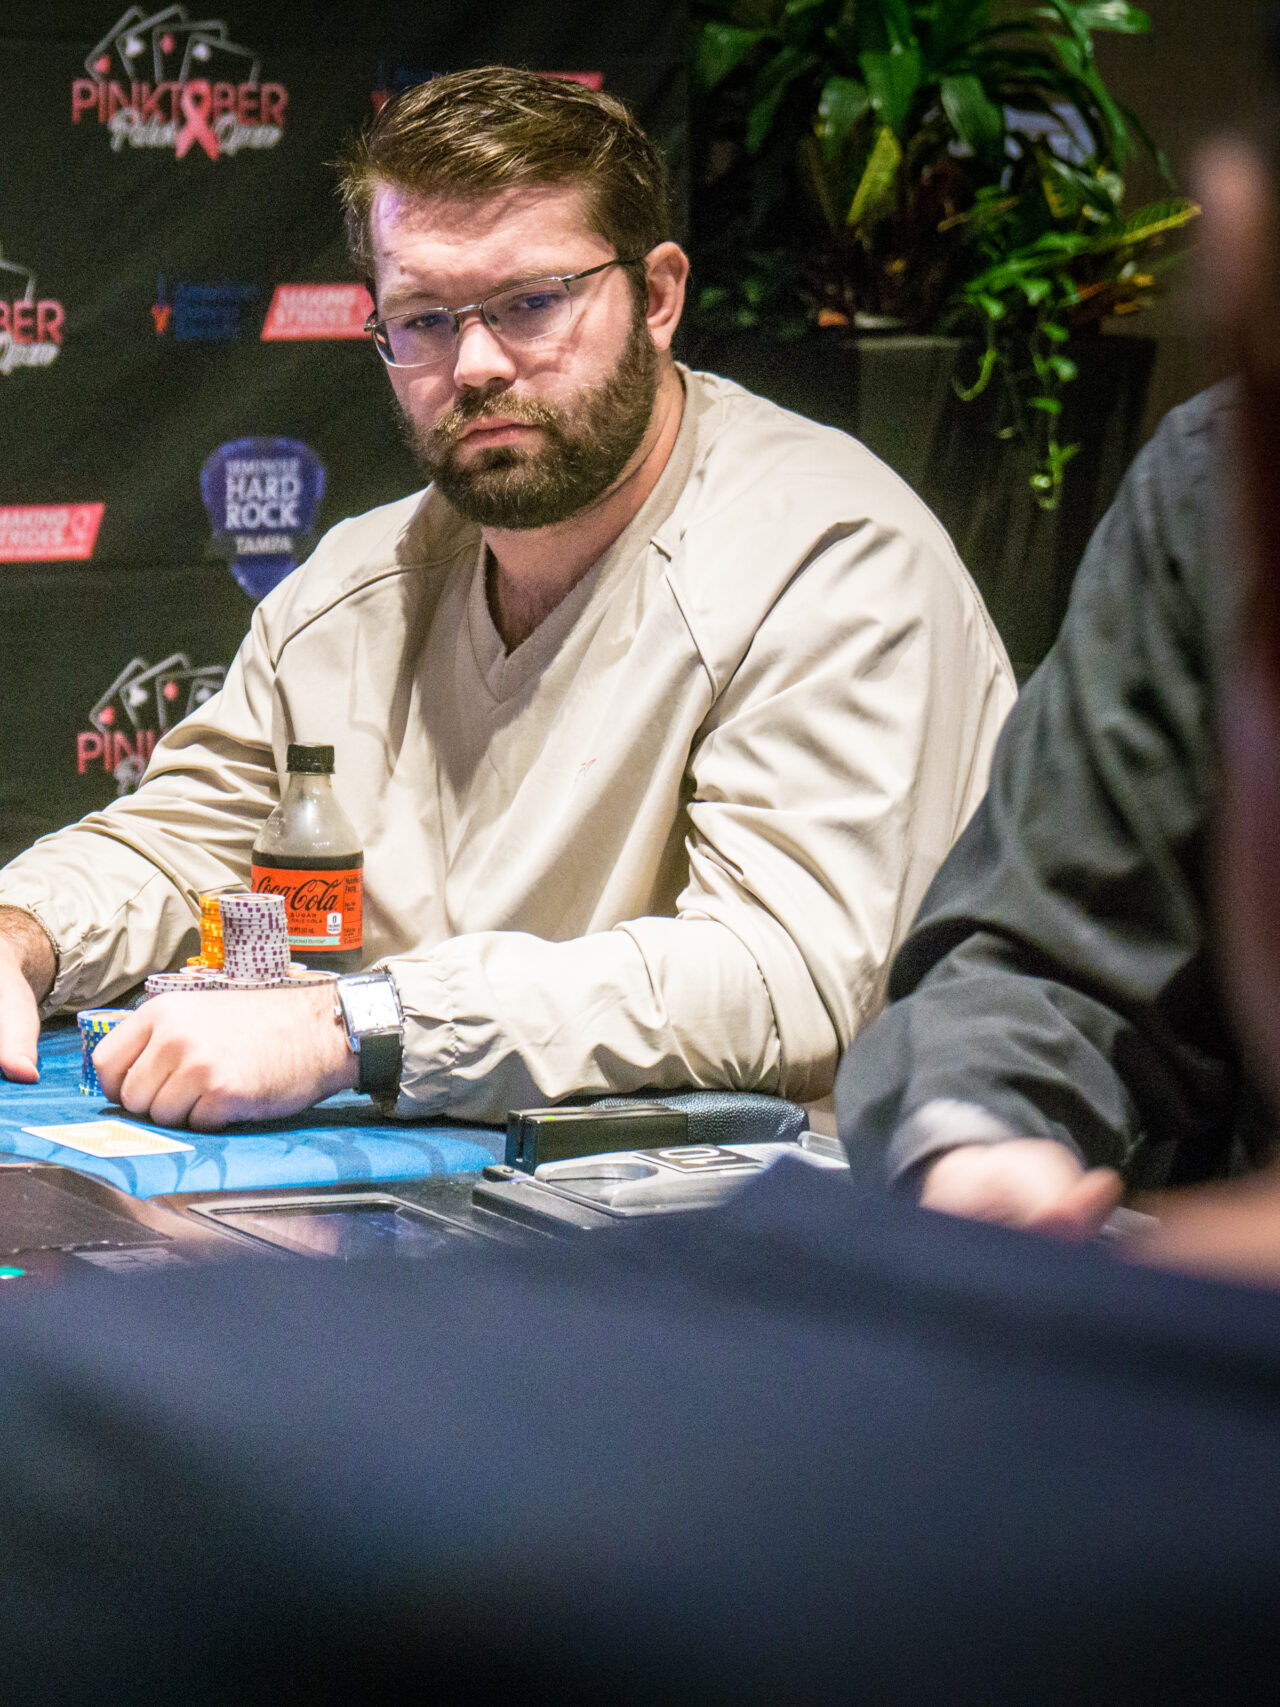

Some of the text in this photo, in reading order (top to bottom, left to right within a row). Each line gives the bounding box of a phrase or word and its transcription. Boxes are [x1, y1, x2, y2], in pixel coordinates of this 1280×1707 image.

[72, 79, 289, 126] PINKTOBER
[225, 475, 303, 501] HARD
[225, 501, 300, 530] ROCK
